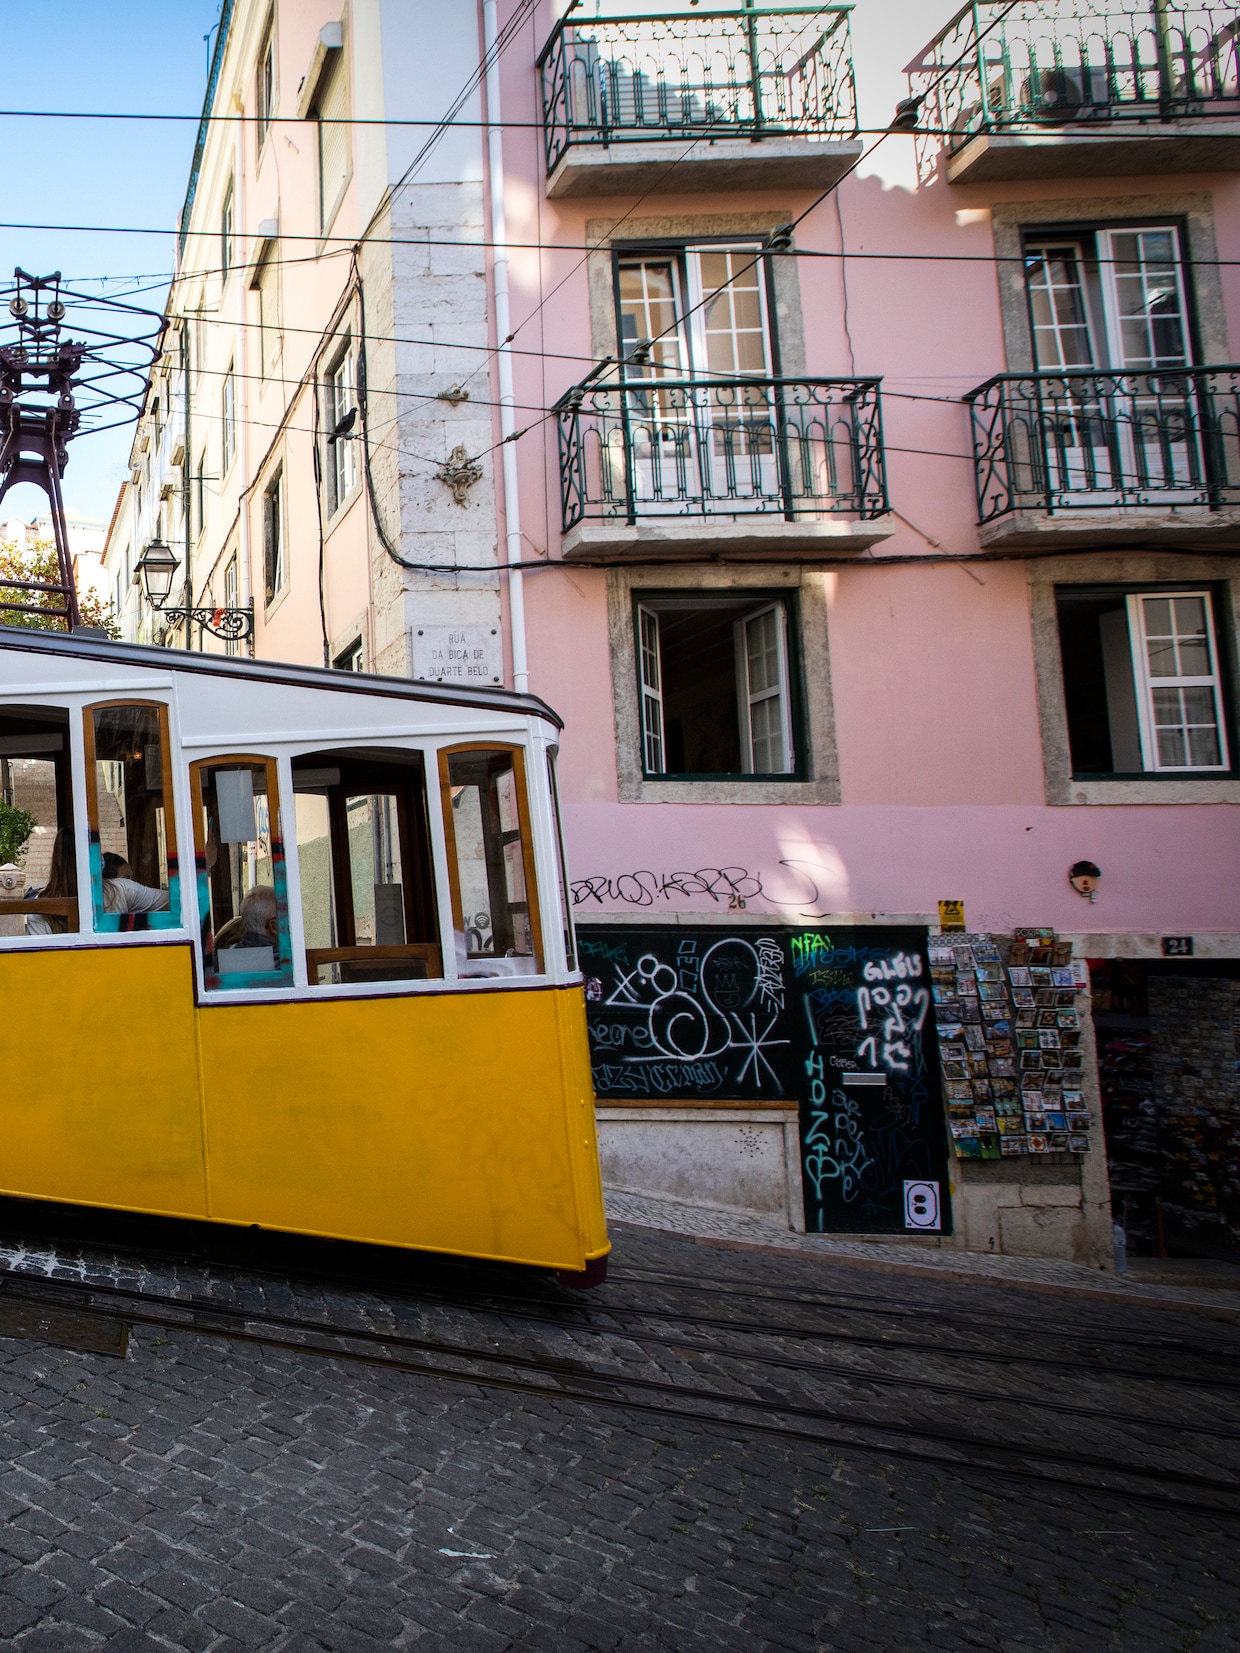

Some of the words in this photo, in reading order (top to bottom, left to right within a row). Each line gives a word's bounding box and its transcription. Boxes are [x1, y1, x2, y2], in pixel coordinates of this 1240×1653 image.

[448, 633, 466, 644] RUA
[432, 649, 444, 660] DA
[448, 649, 468, 660] BICA
[473, 649, 484, 660] DE
[429, 666, 463, 677] DUARTE
[467, 665, 489, 676] BELO
[728, 894, 747, 910] 26
[1169, 939, 1189, 954] 24
